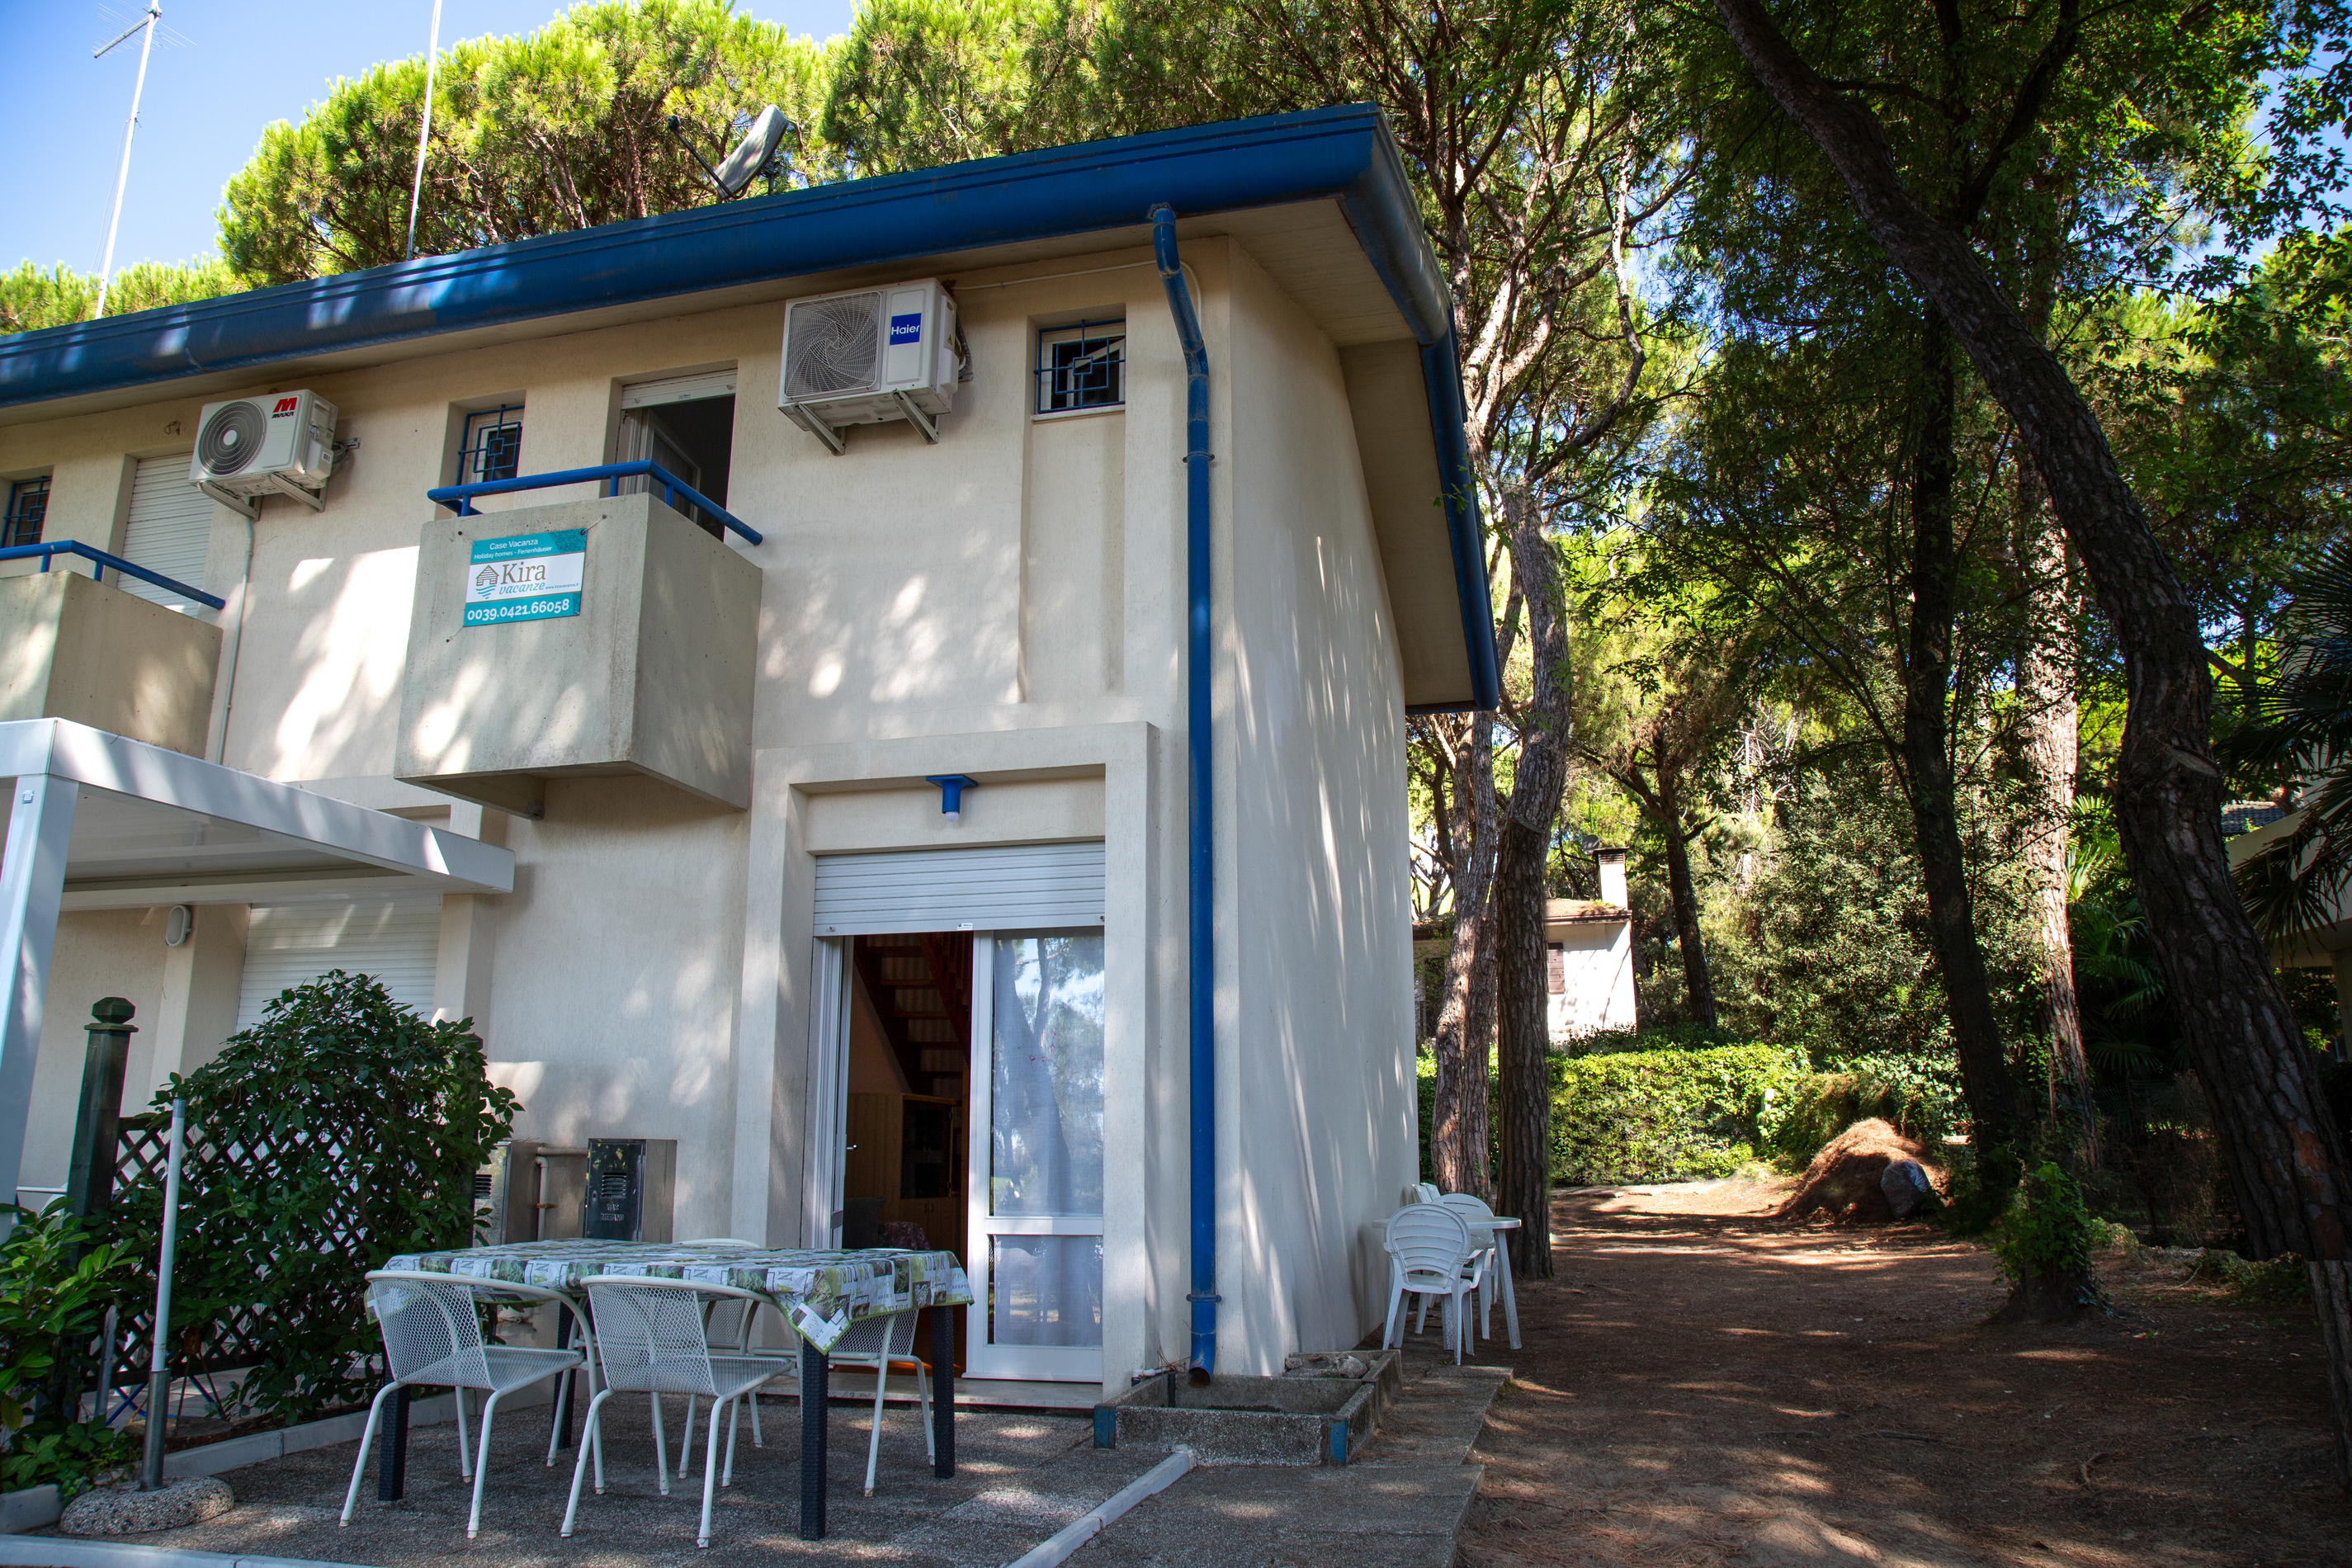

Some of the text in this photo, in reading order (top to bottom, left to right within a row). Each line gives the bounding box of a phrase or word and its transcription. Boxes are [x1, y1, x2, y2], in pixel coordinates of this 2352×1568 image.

[890, 324, 920, 336] Haier
[489, 538, 538, 550] Case Vacanza
[517, 545, 552, 555] Ferienhäuser
[500, 561, 546, 584] Kira
[498, 582, 545, 595] vacanze
[467, 598, 569, 621] 0039.0421.66058
